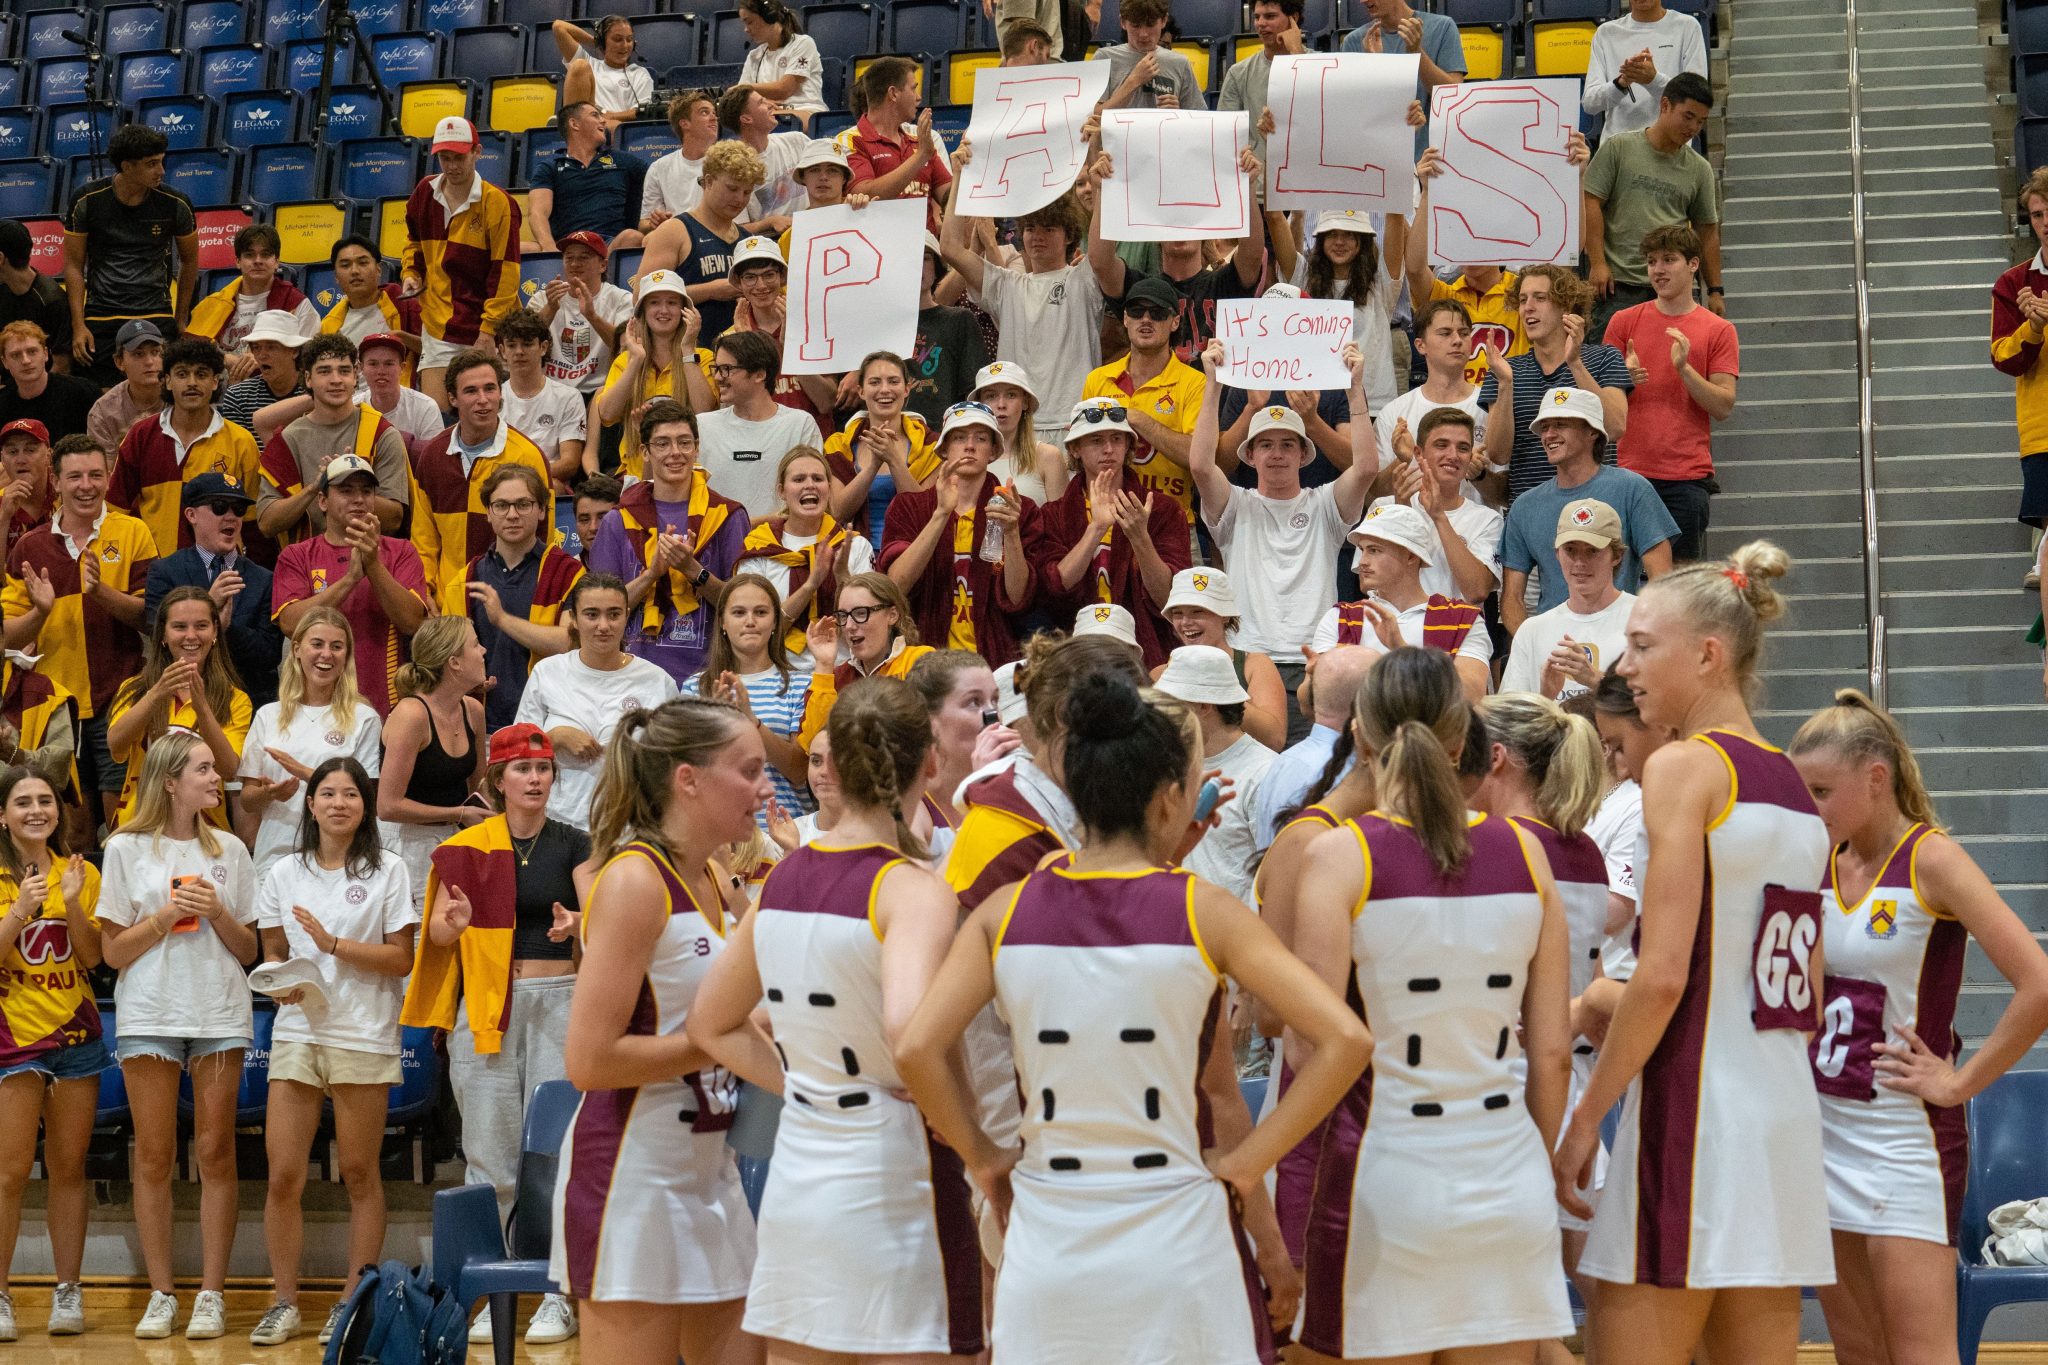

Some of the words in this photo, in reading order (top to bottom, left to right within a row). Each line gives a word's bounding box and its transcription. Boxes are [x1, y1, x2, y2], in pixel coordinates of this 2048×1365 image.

[234, 119, 282, 129] ELEGANCY
[330, 114, 367, 123] EGANCY
[1276, 58, 1385, 197] L
[0, 136, 23, 144] ANCY
[267, 164, 285, 172] David
[198, 224, 225, 236] ydney
[700, 254, 726, 277] NEW
[800, 229, 883, 361] P
[1224, 304, 1268, 337] It's
[545, 363, 598, 380] RUGBY
[1231, 345, 1313, 381] Home.
[344, 456, 361, 469] T
[1755, 910, 1817, 1012] GS
[1815, 995, 1854, 1079] C
[402, 1060, 421, 1068] Club
